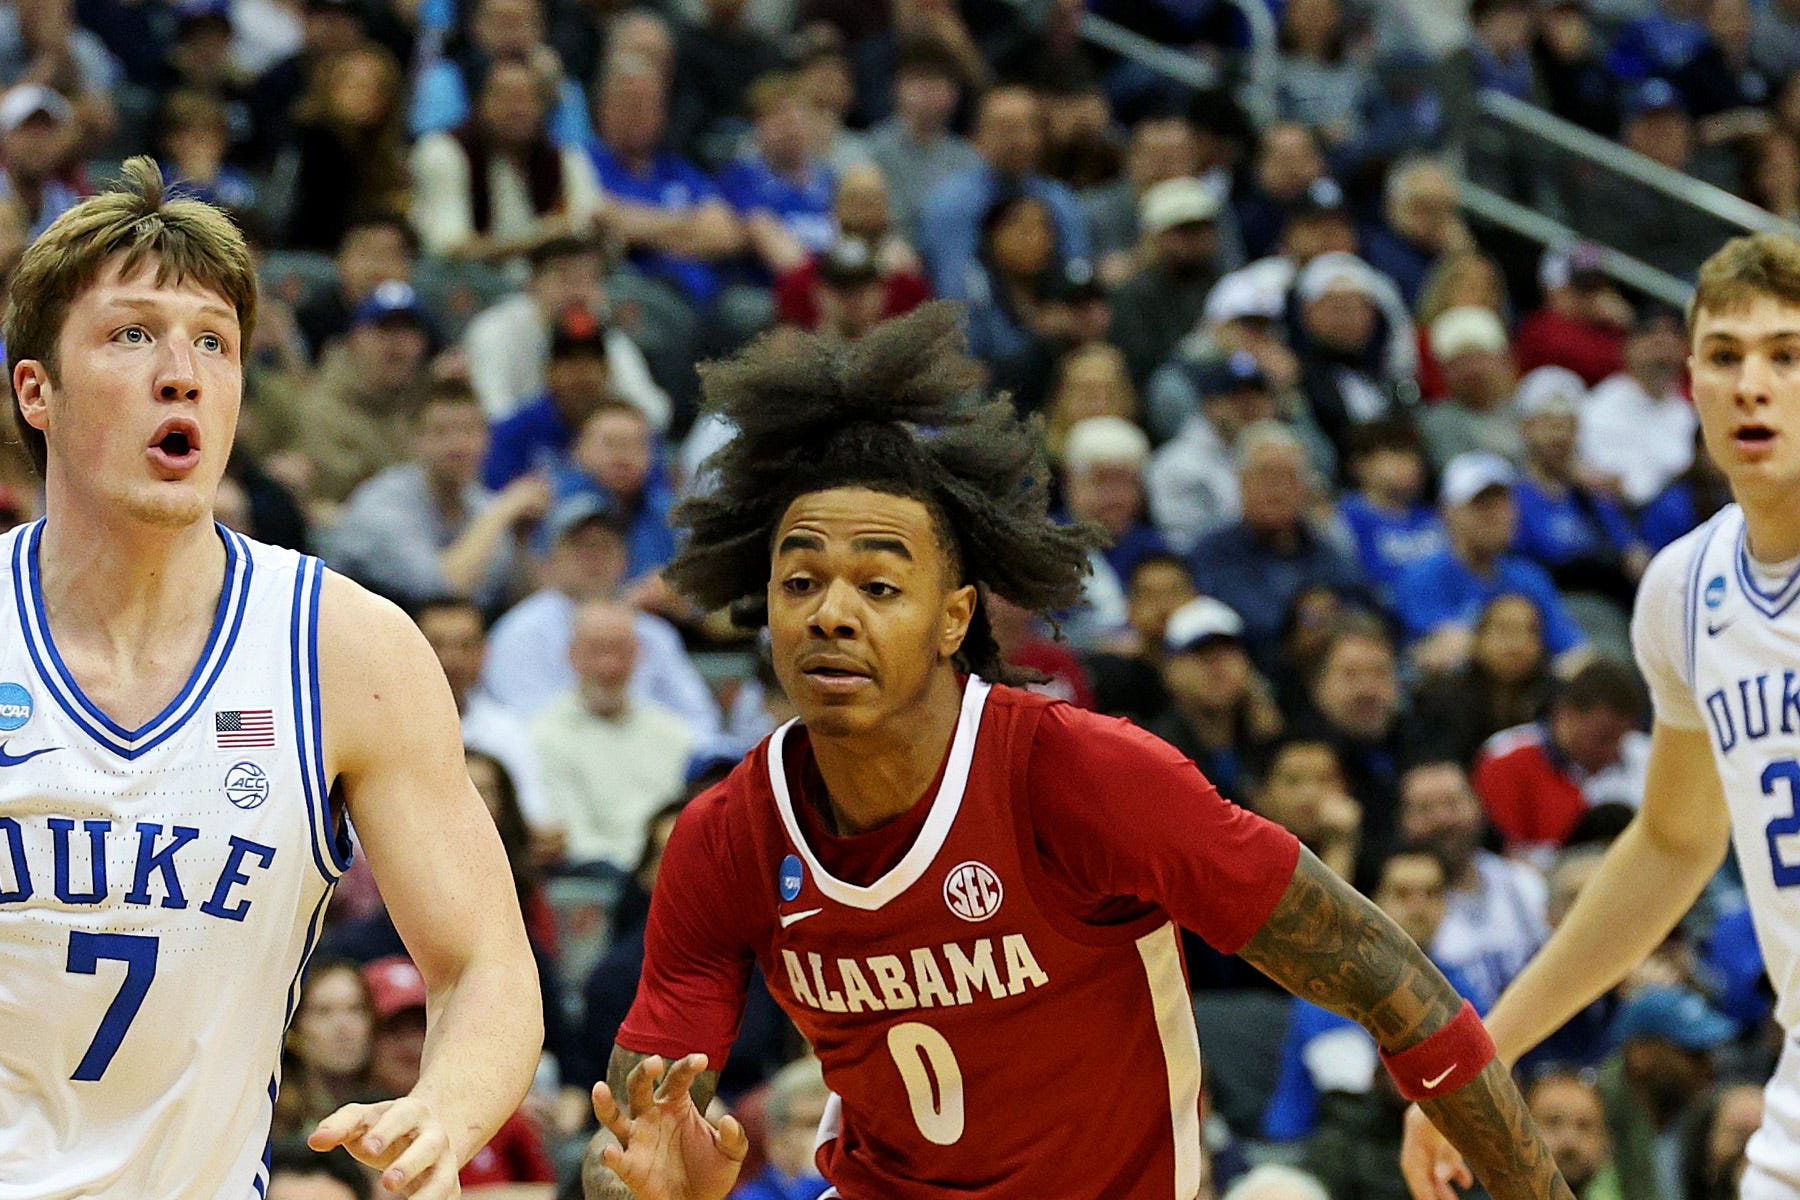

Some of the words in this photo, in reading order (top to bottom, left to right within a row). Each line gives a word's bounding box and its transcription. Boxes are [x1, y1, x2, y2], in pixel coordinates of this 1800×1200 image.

[1706, 671, 1800, 754] DUK
[231, 777, 266, 788] ACC
[1761, 760, 1800, 888] 2
[947, 866, 998, 918] SEC
[66, 930, 160, 1082] 7
[781, 933, 1049, 1013] ALABAMA
[887, 1022, 965, 1146] 0
